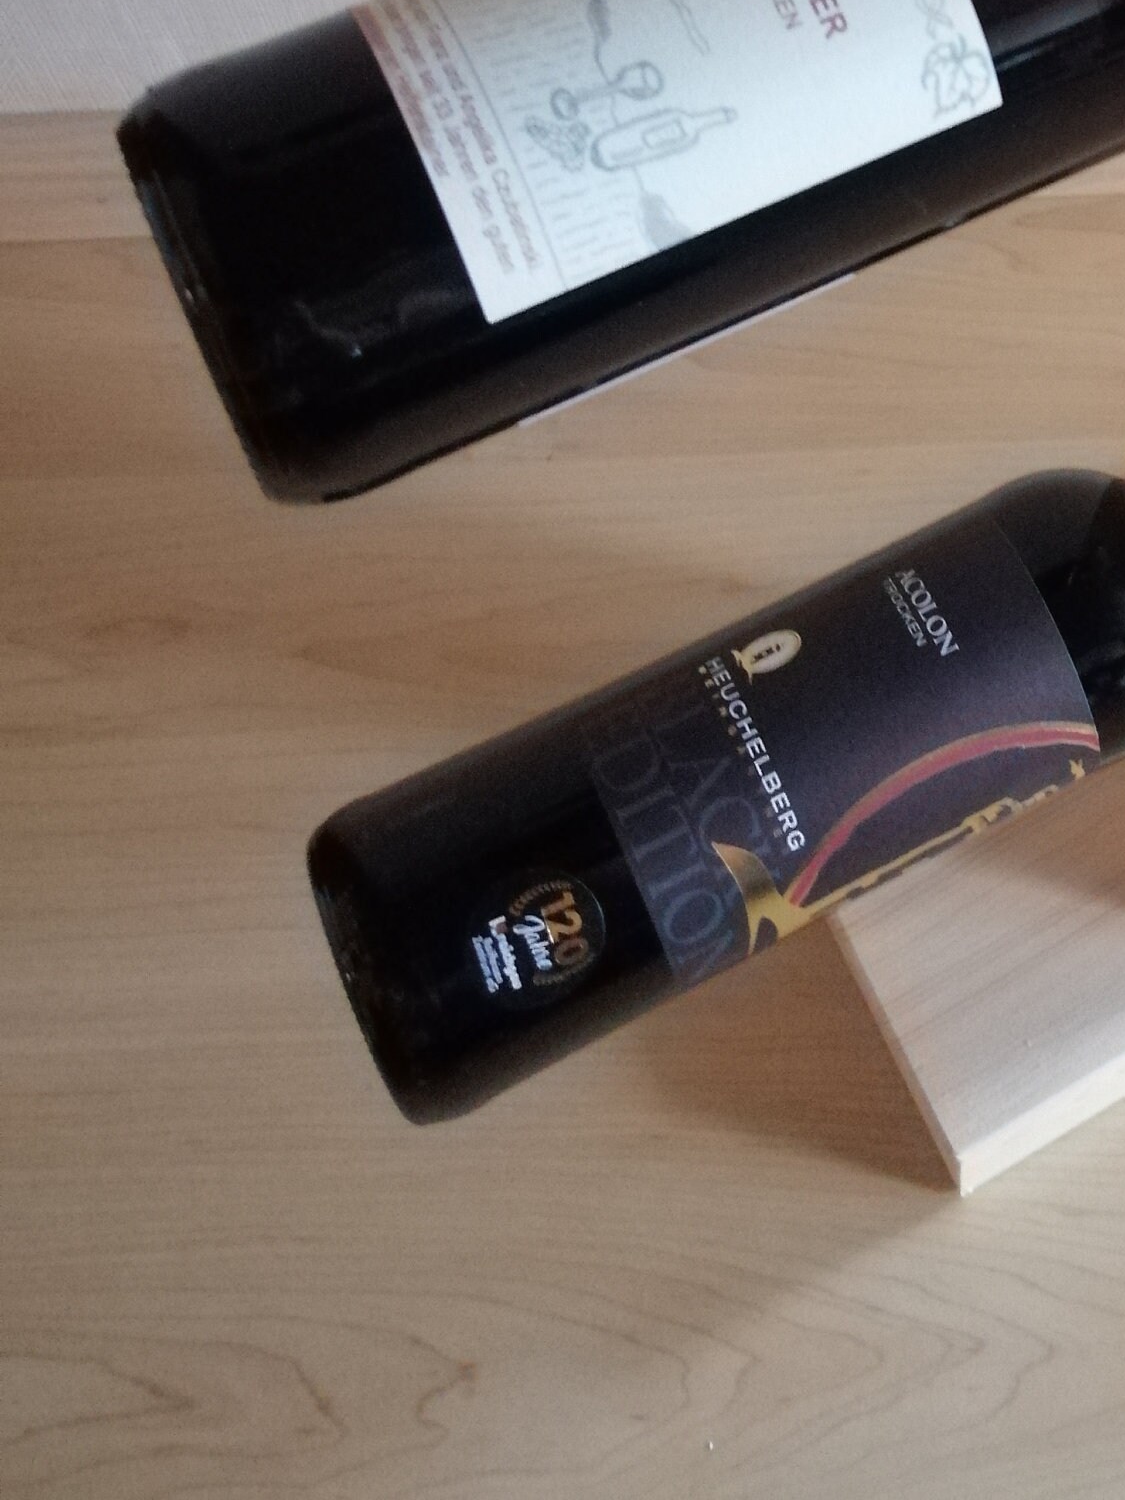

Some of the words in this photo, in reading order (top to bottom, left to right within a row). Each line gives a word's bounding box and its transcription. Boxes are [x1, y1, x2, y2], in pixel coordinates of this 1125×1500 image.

[894, 568, 959, 656] ACOLON
[704, 656, 805, 851] HEUCHELBERG
[511, 915, 554, 970] Jahre
[539, 891, 584, 964] 120
